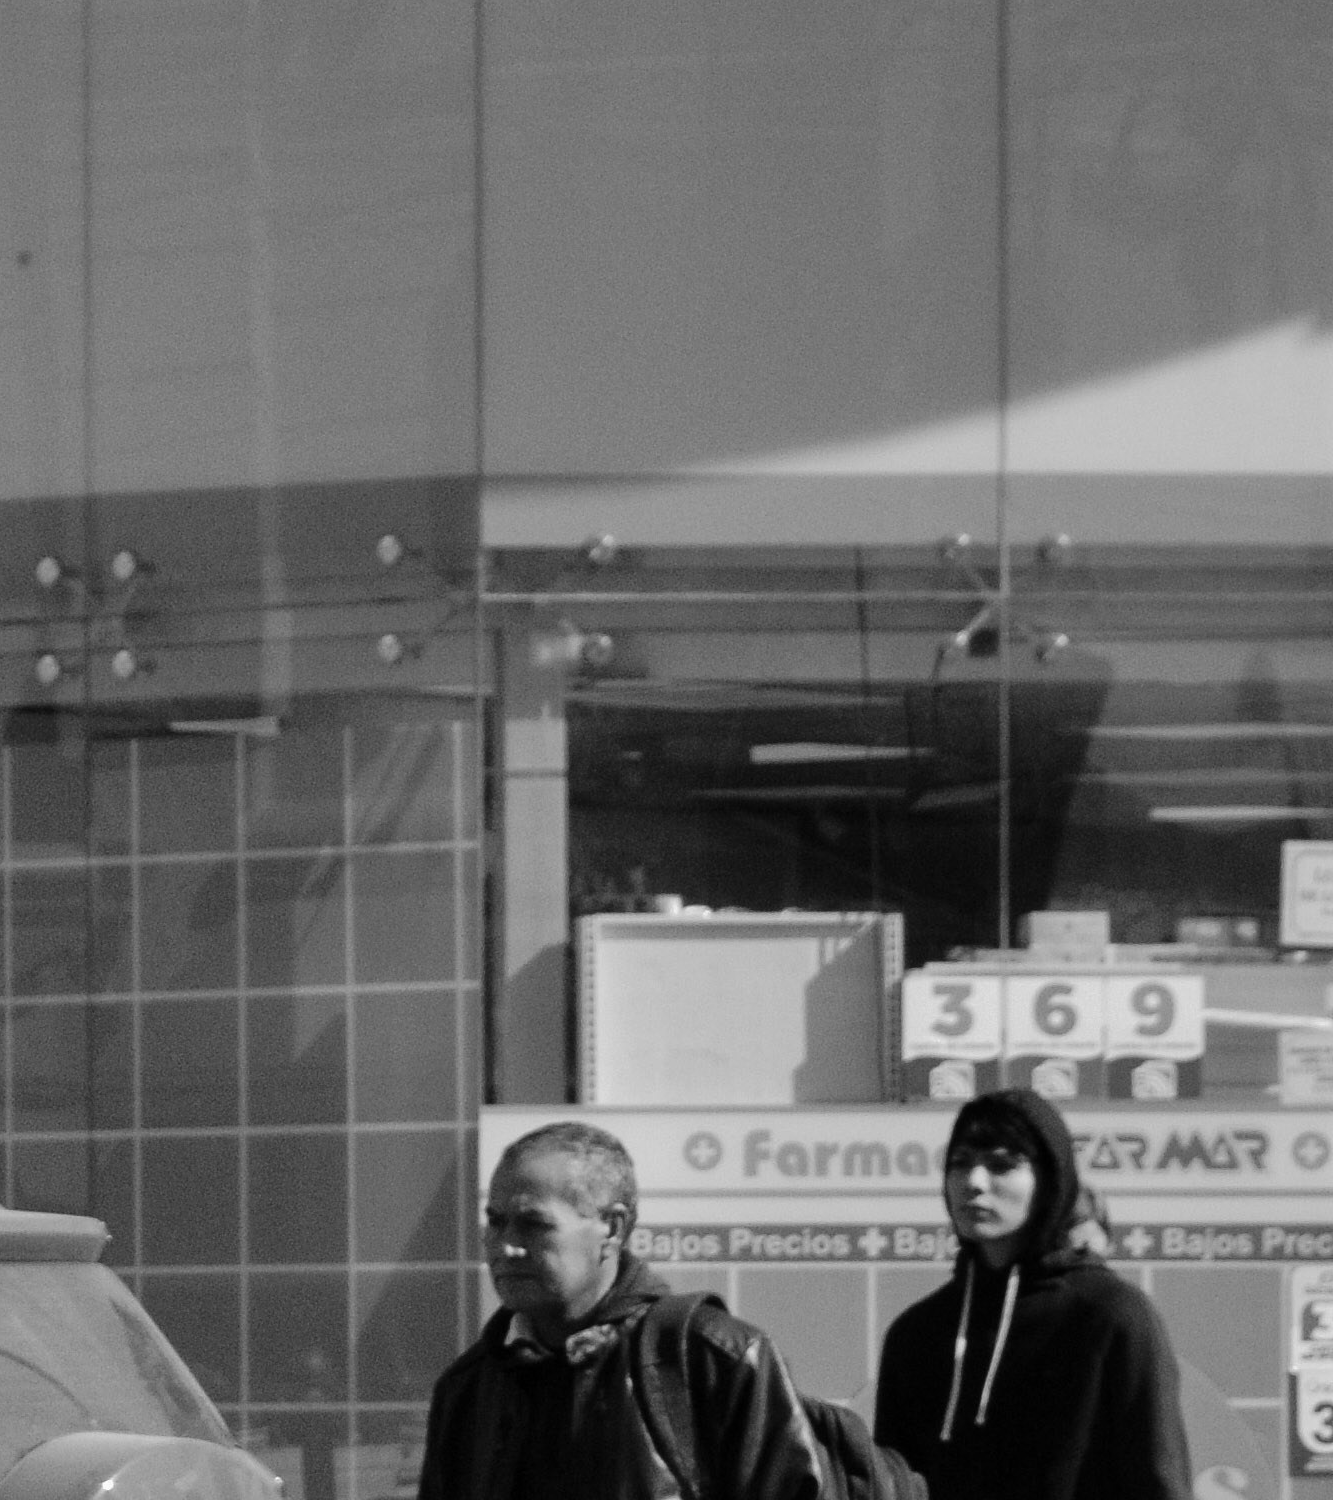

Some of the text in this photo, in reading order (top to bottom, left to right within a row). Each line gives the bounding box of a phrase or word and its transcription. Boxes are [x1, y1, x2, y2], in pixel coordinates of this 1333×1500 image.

[931, 982, 1175, 1037] 3 6 9
[743, 1128, 933, 1178] Farma
[629, 1227, 721, 1261] Bajos
[729, 1227, 851, 1257] Precios
[1161, 1226, 1253, 1261] Bajos
[1261, 1226, 1333, 1257] Prec
